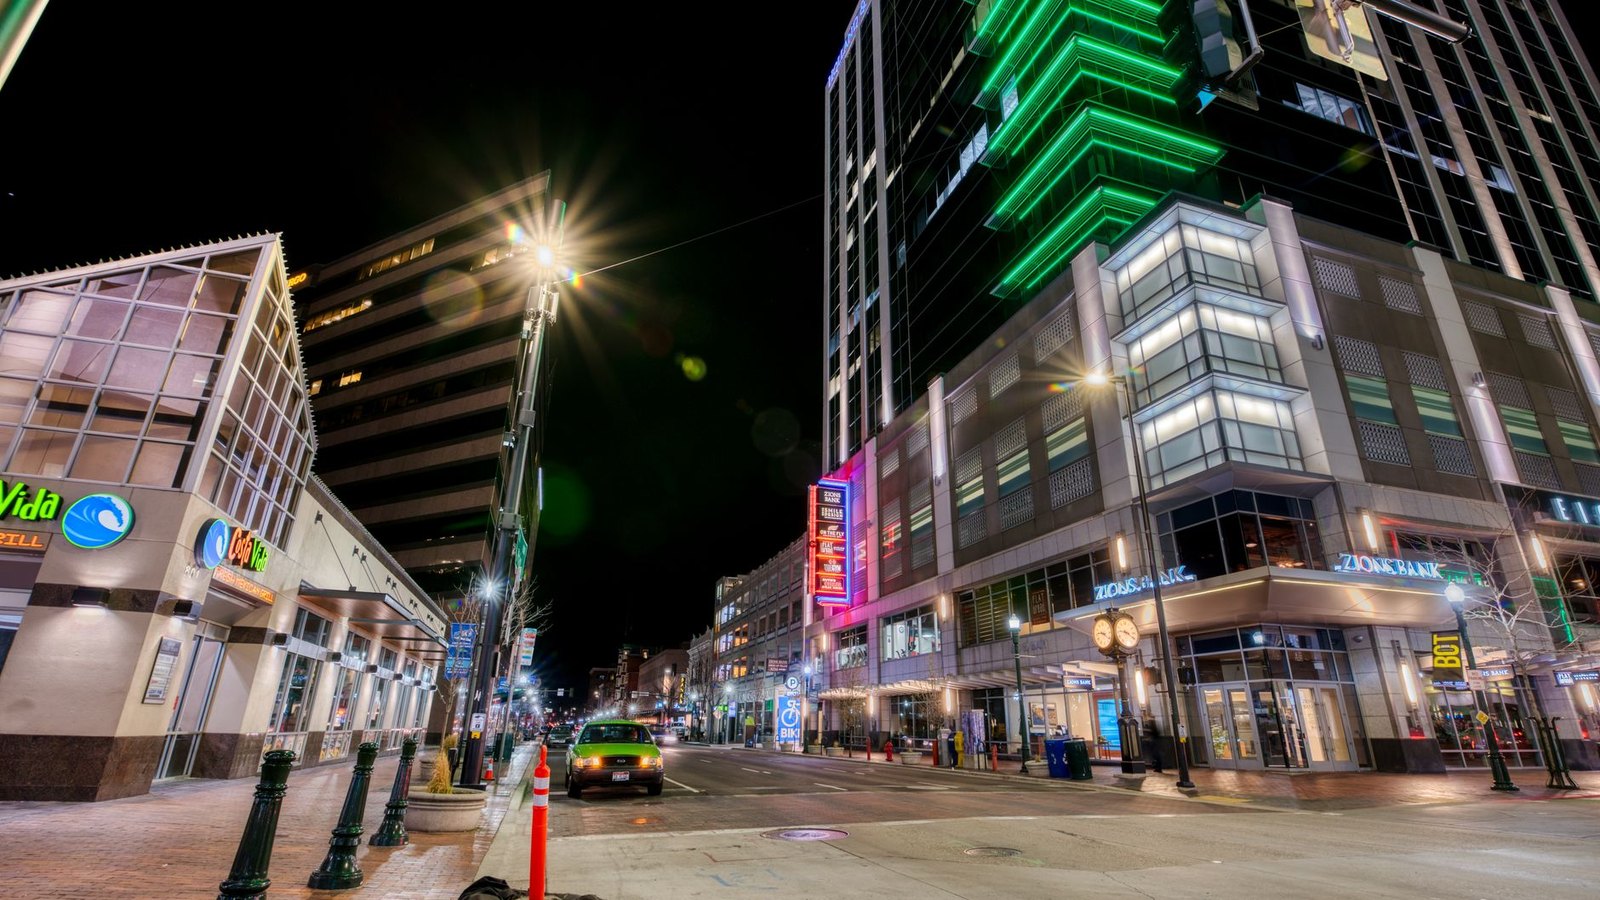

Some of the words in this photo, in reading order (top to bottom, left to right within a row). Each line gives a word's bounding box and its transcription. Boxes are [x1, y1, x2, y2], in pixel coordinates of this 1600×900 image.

[0, 480, 61, 520] Vida
[250, 536, 268, 572] Vida
[1338, 553, 1397, 575] ZIONS
[1397, 559, 1443, 579] BANK
[1094, 577, 1140, 600] ZIONS
[1432, 633, 1461, 668] BOT
